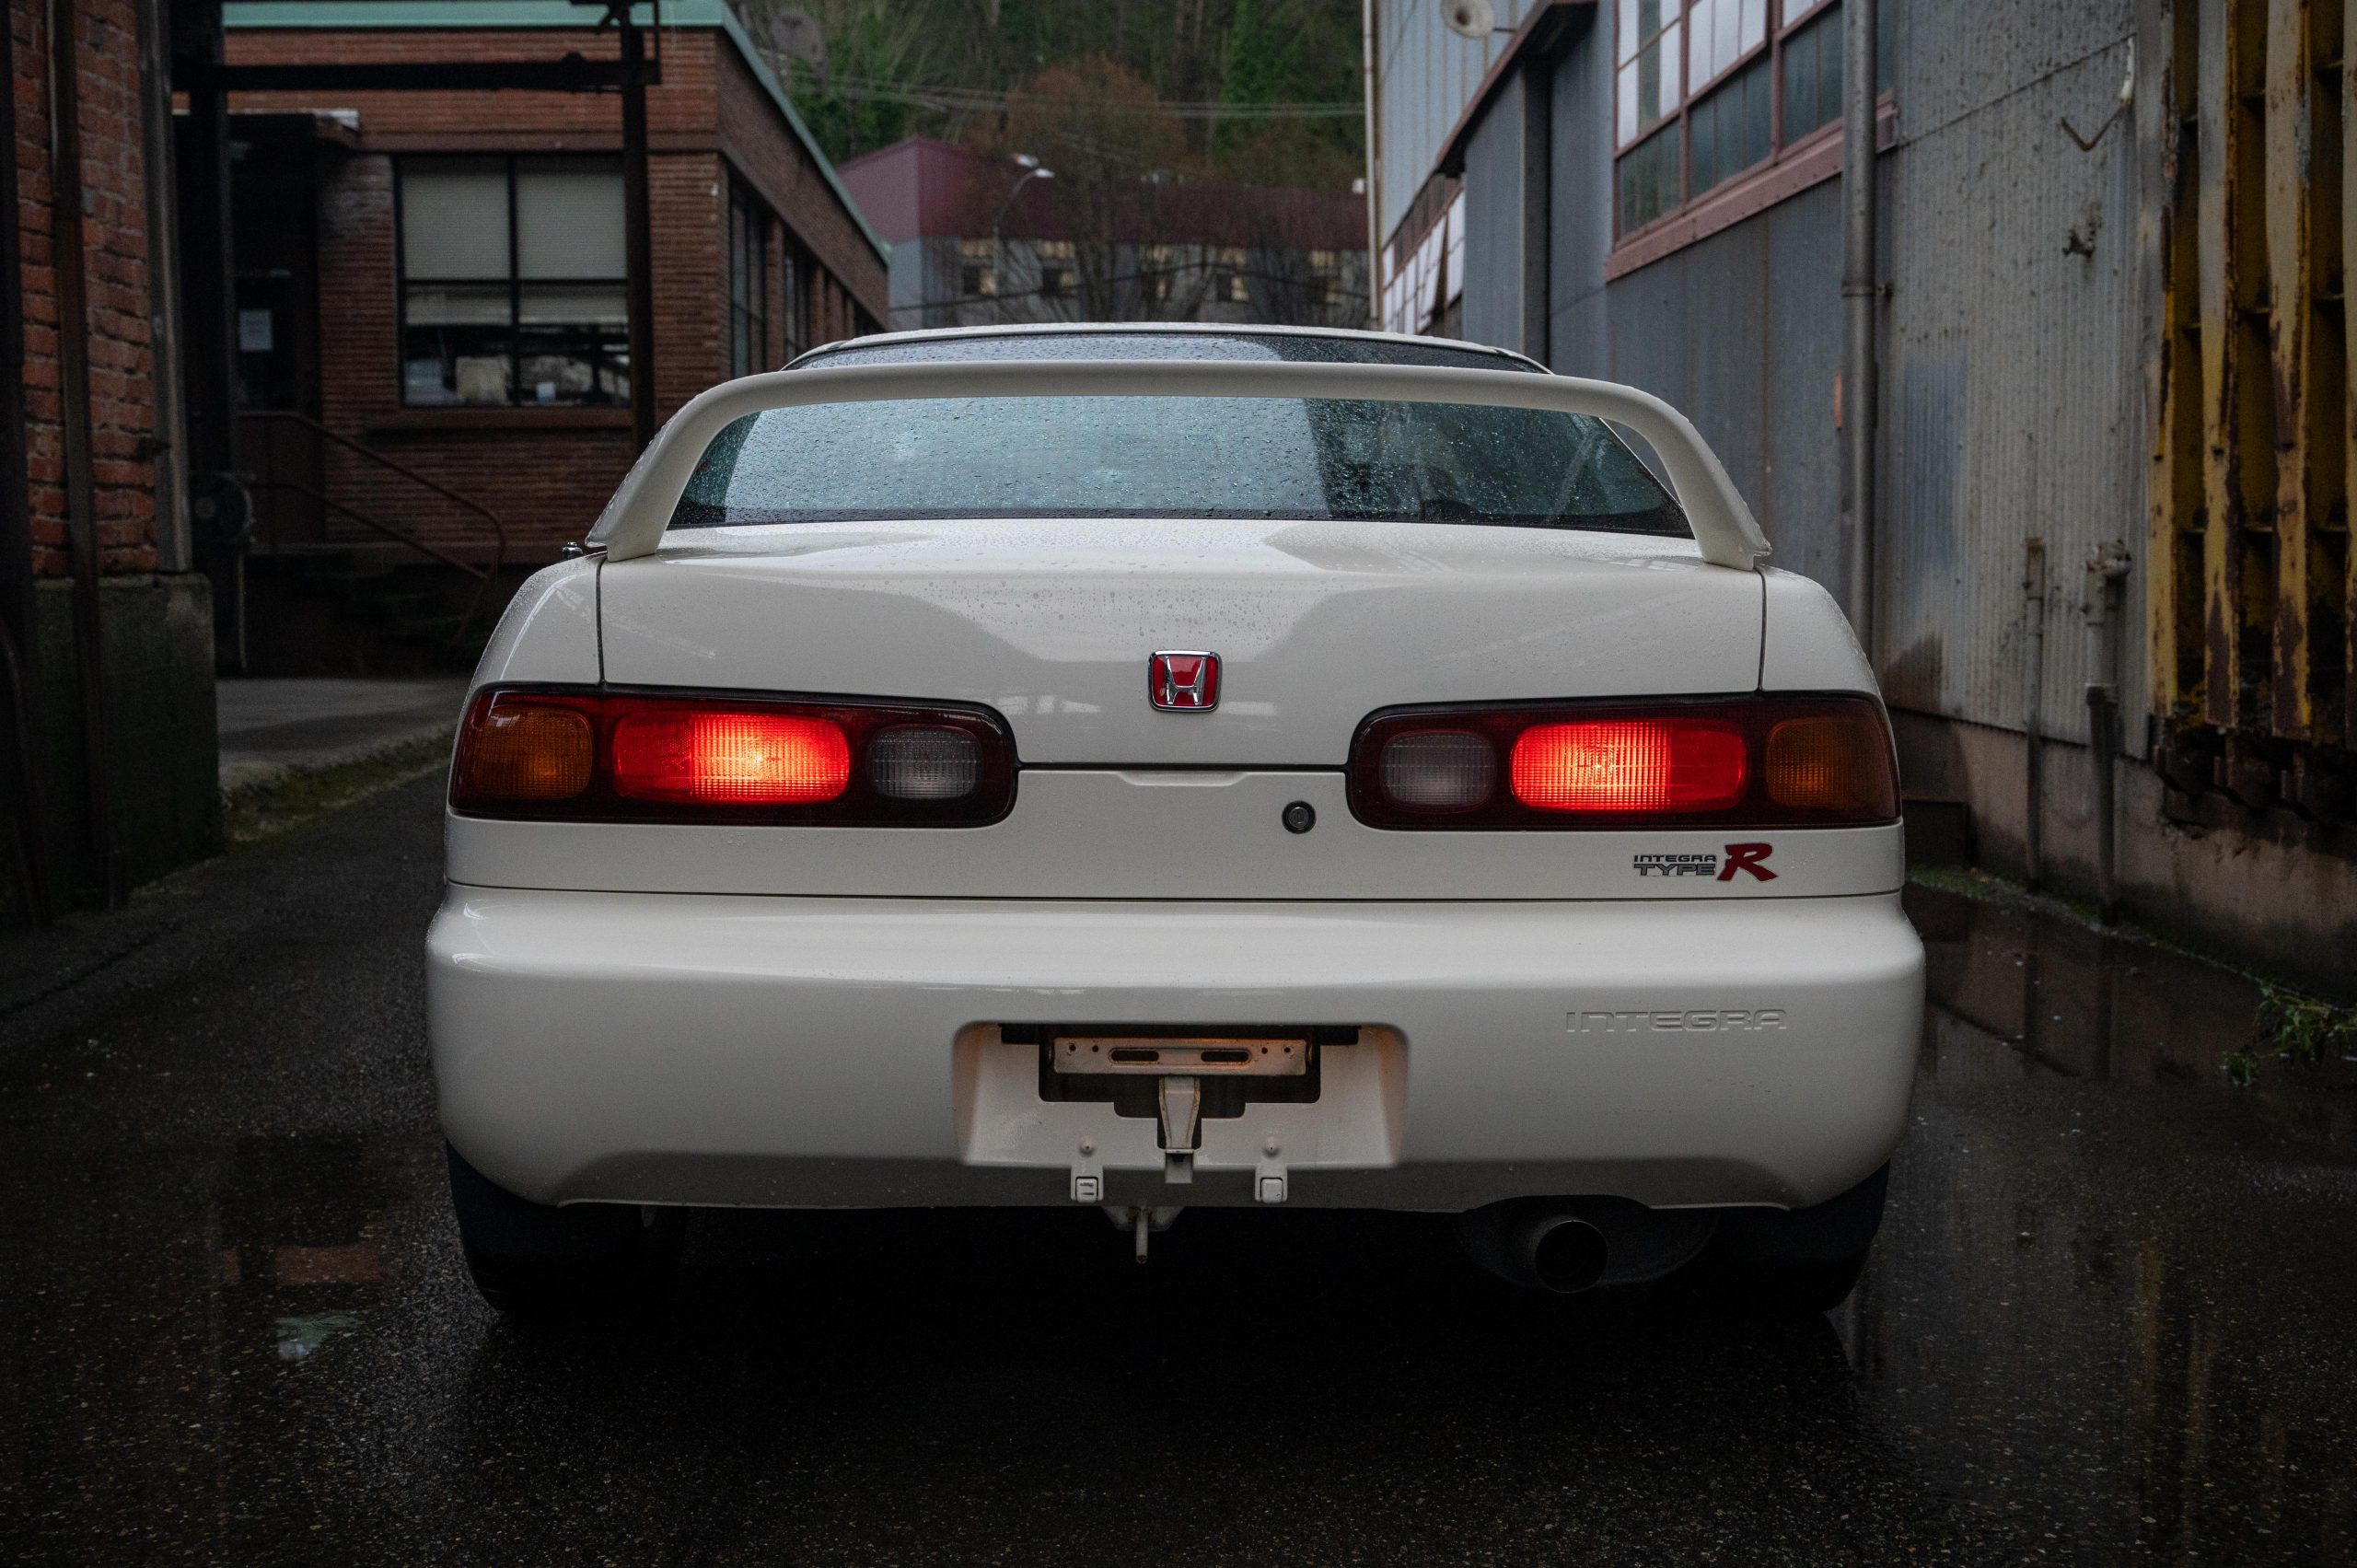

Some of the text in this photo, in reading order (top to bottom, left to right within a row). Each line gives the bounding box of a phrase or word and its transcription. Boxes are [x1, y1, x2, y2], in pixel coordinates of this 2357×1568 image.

[1633, 854, 1717, 863] INTEGRA
[1633, 842, 1779, 882] TYPE R
[1566, 1009, 1788, 1033] INTEGRA
